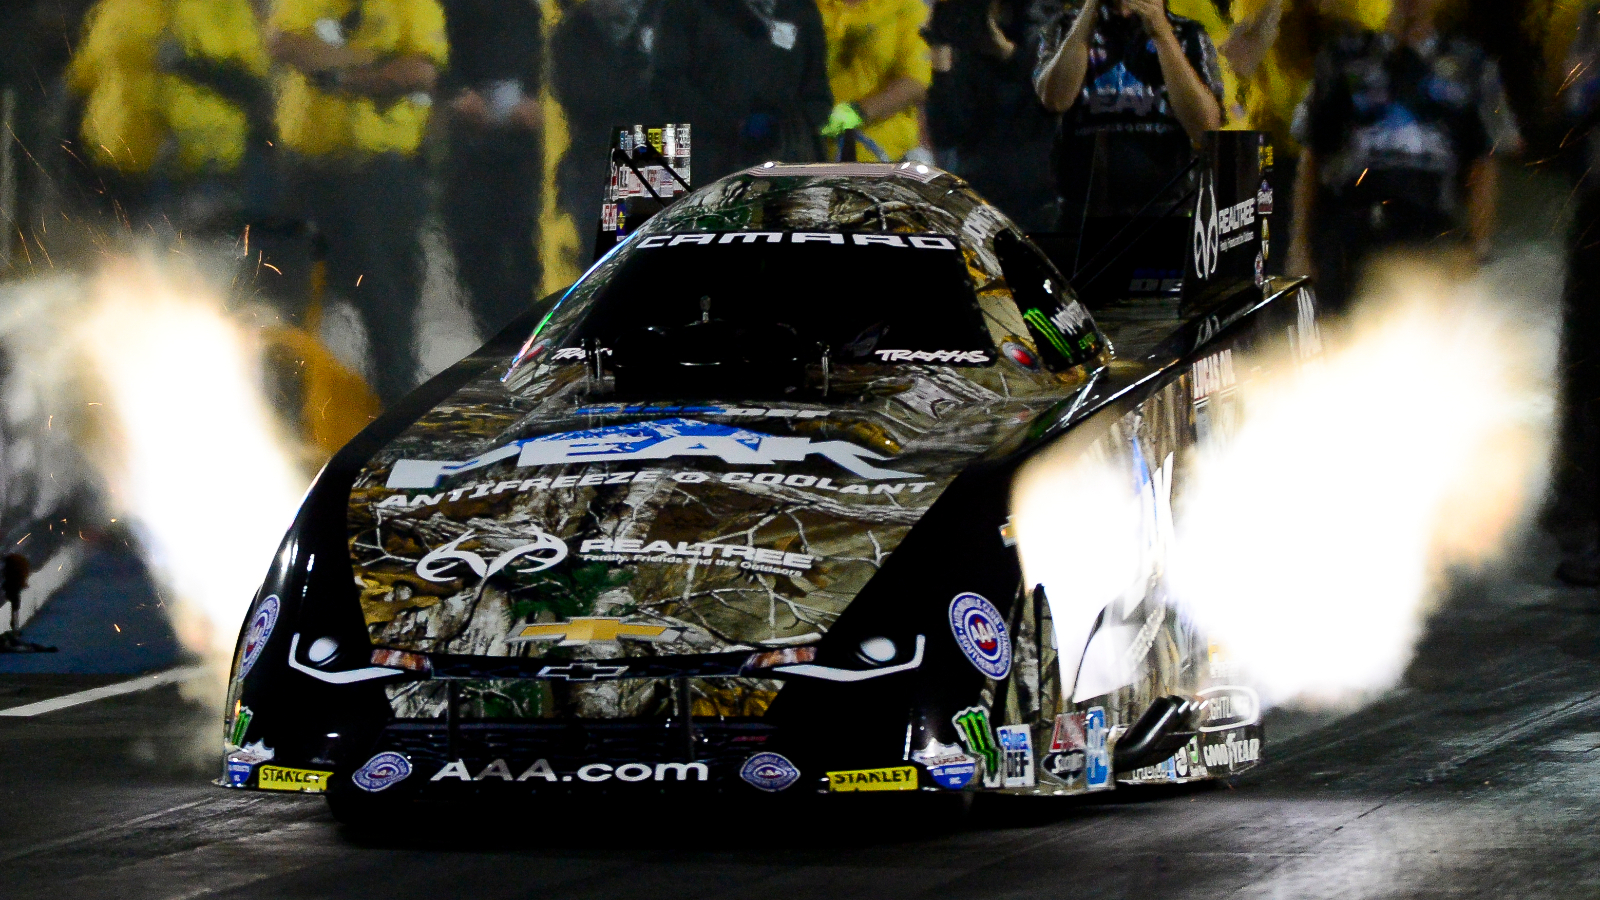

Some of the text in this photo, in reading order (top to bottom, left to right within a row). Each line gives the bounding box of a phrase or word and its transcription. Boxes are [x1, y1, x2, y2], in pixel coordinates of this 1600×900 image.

[1218, 197, 1256, 235] REALTREE
[635, 231, 957, 250] CAMARO
[875, 349, 990, 363] TRAXXAS
[388, 430, 925, 487] PEAK
[376, 471, 660, 508] ANTIFREEZE
[720, 471, 936, 495] COOLANT
[579, 537, 813, 569] REALTREE
[583, 553, 803, 577] Family, Friends and the Outdoors
[429, 757, 709, 782] AAA.com
[834, 768, 912, 785] STANLEY
